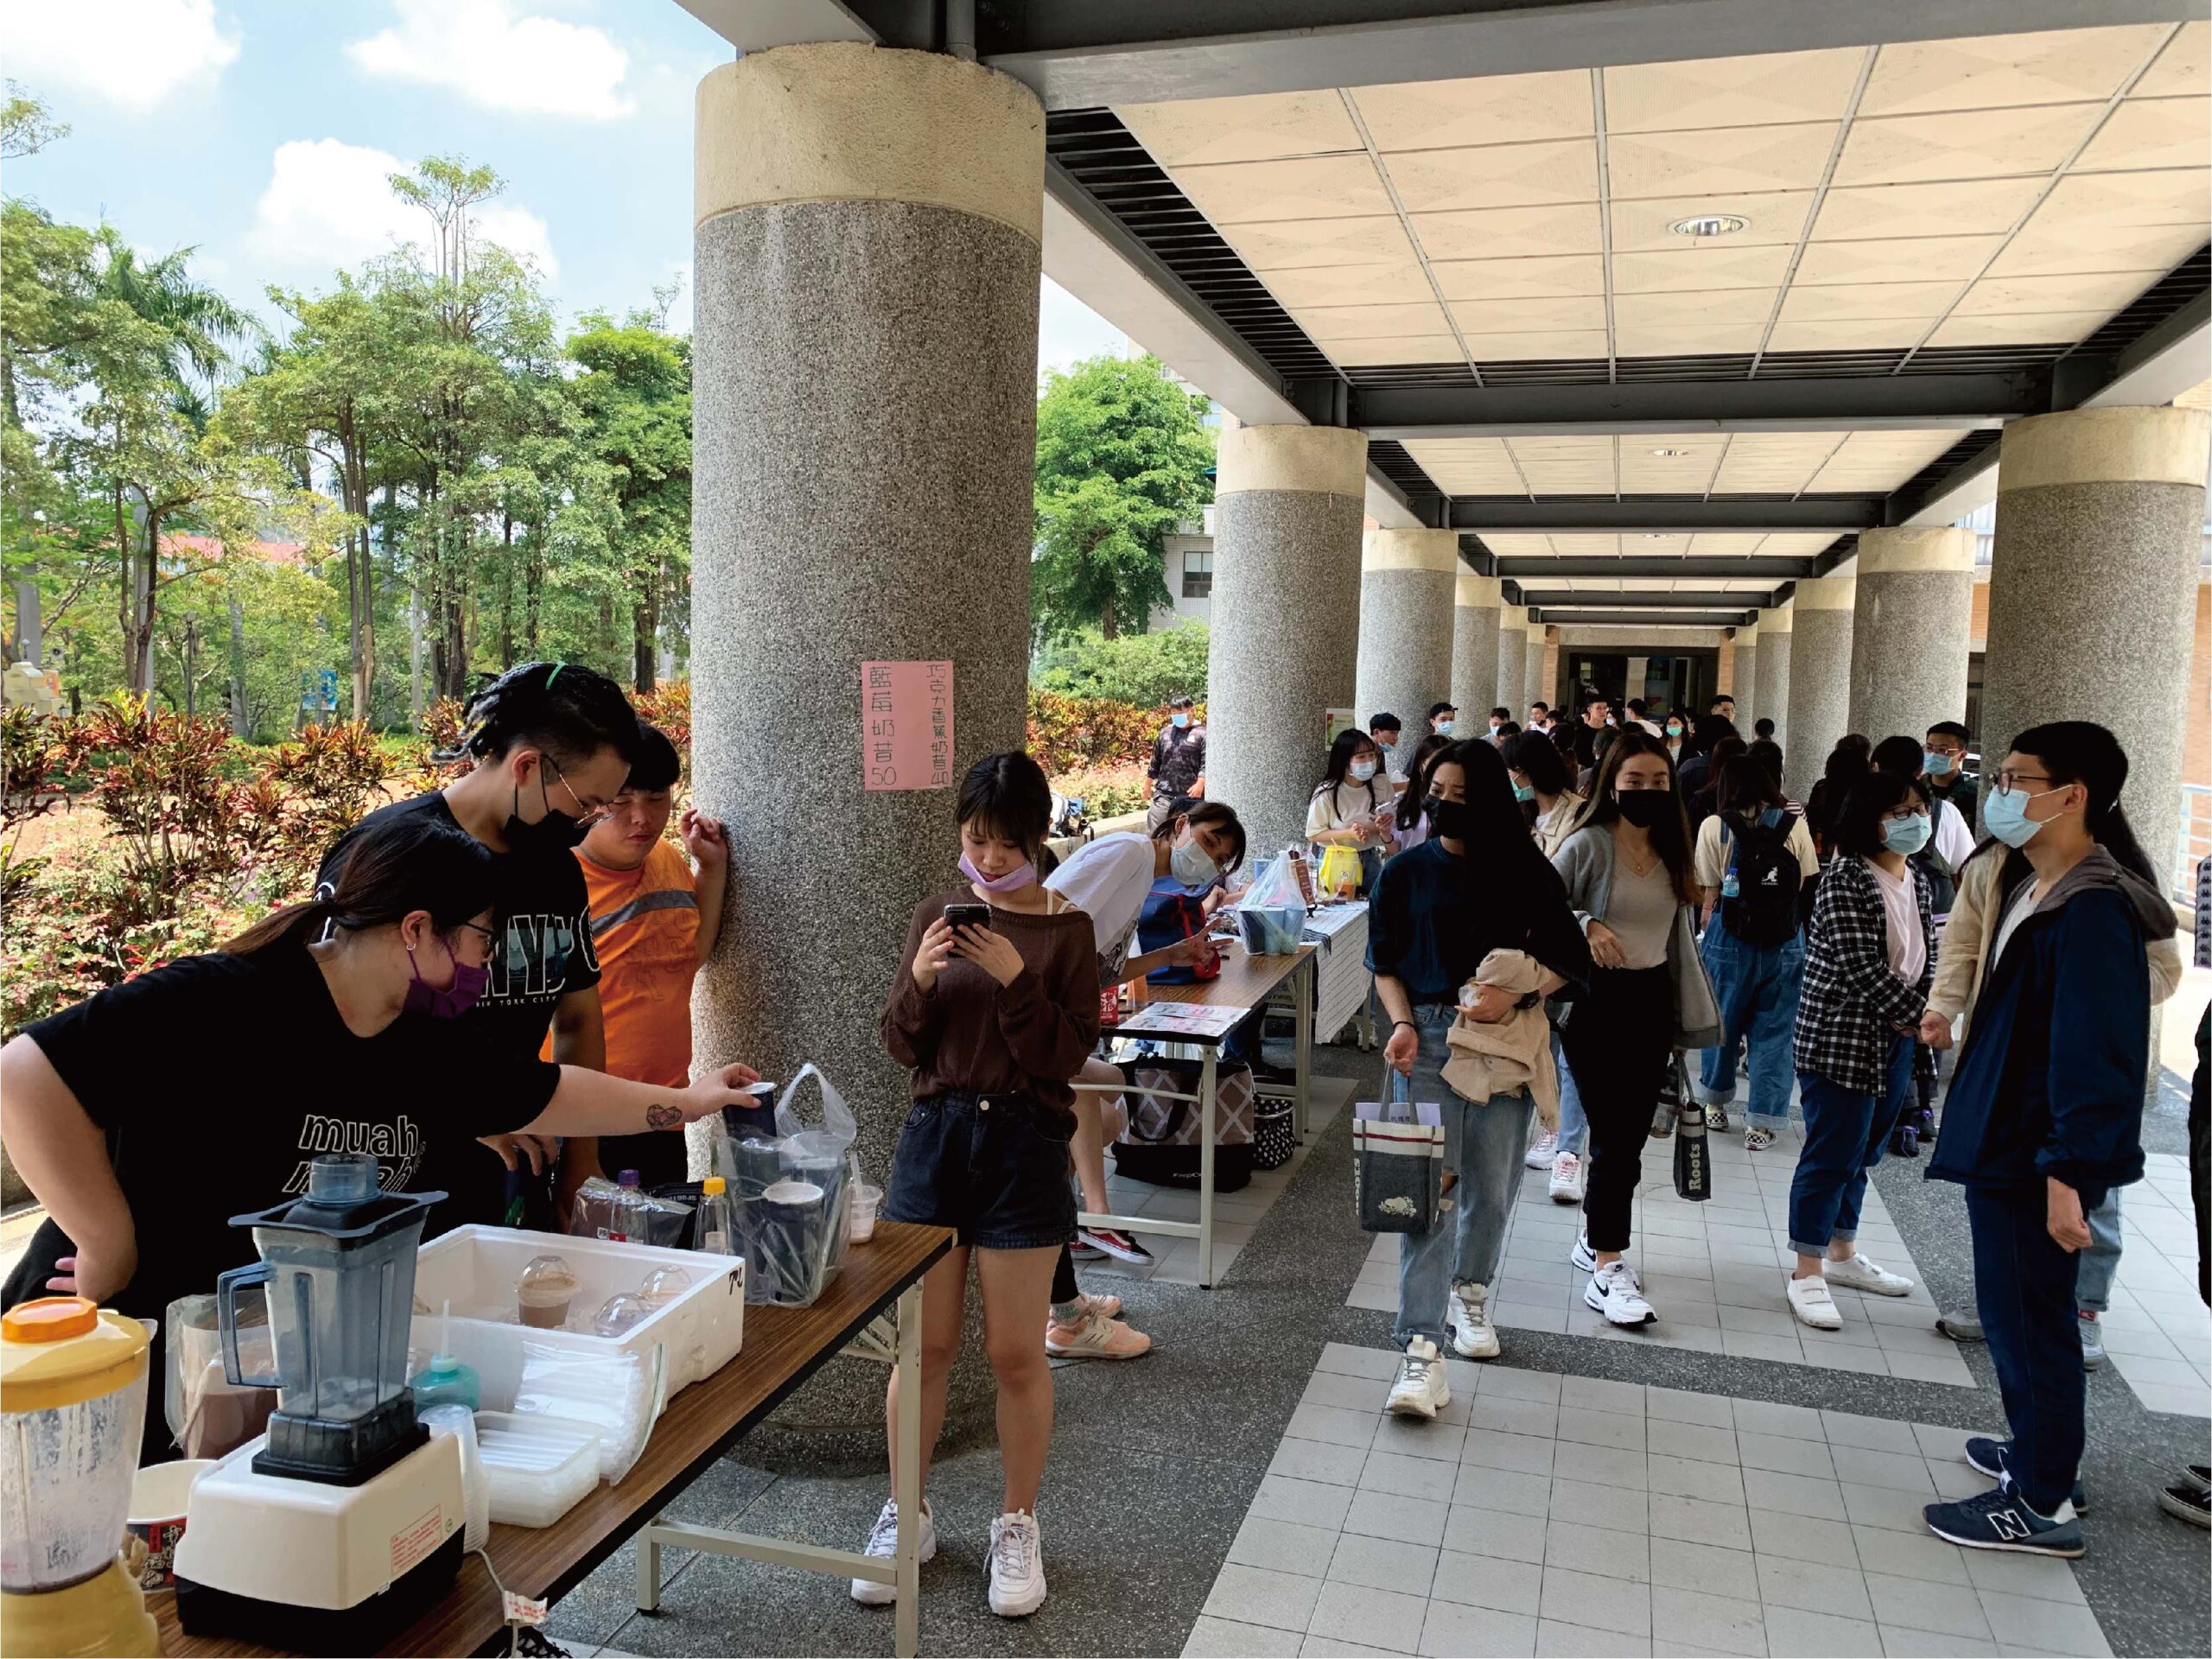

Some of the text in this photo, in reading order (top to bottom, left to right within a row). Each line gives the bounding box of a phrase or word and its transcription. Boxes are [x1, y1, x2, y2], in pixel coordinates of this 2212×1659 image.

[871, 766, 897, 785] 50
[297, 1114, 419, 1157] muah
[1688, 1143, 1701, 1191] Roots
